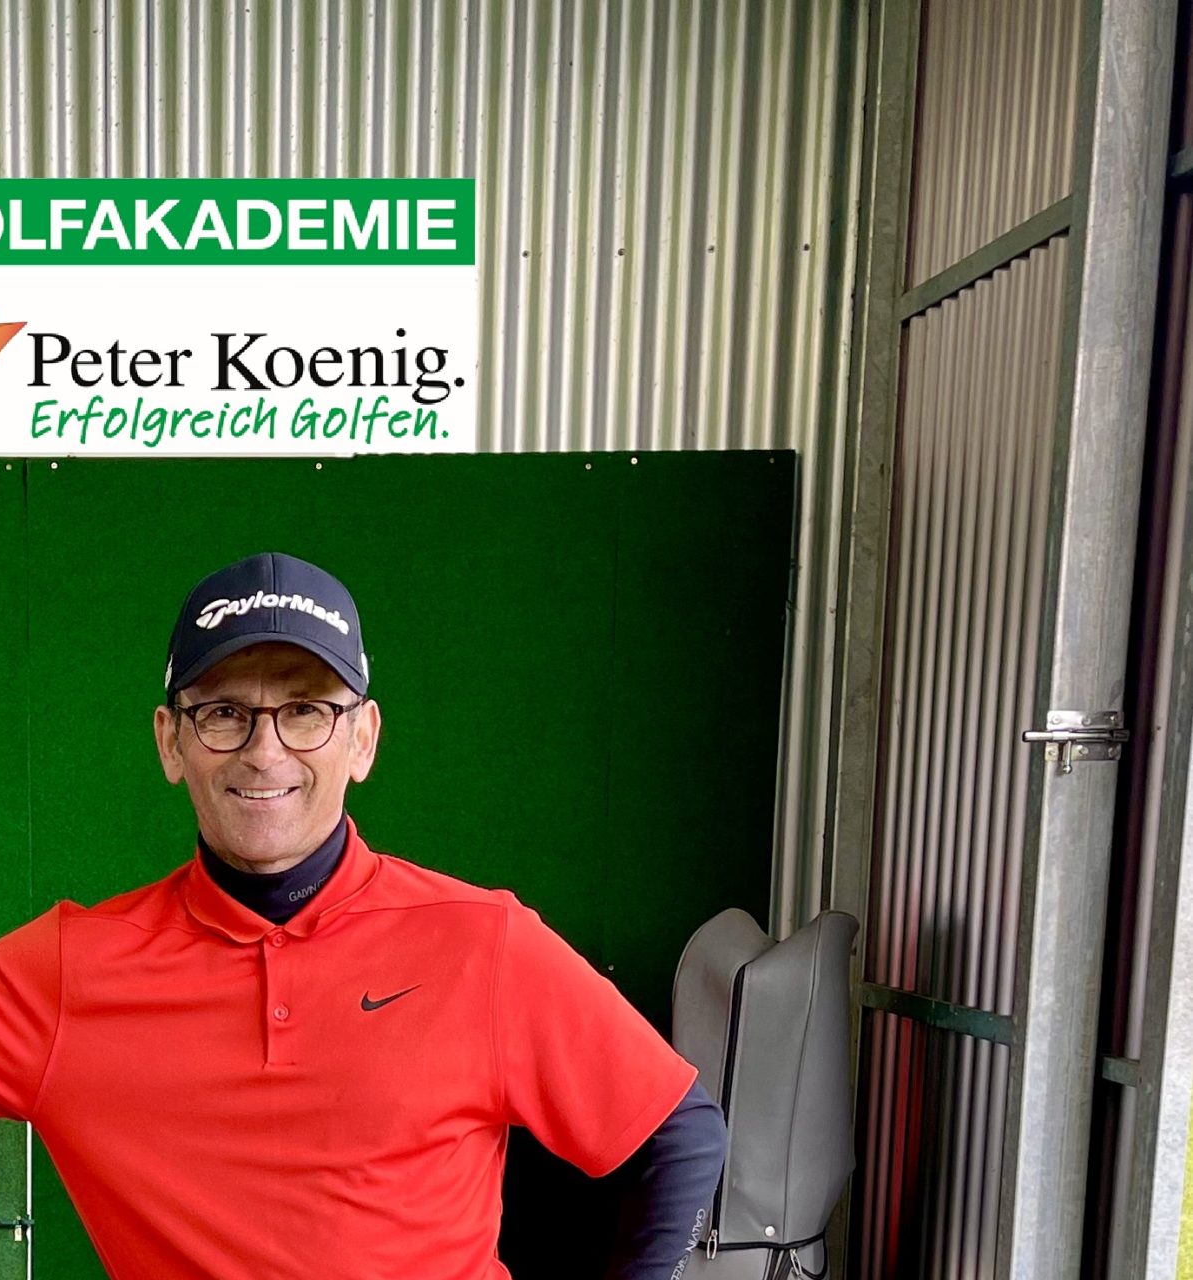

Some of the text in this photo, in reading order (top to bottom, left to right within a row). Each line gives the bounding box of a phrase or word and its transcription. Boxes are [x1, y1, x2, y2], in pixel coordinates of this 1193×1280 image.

[27, 327, 465, 405] Peter Koenig.
[30, 395, 450, 448] Erfolgreich Golfen.
[195, 590, 350, 635] TaylorMade
